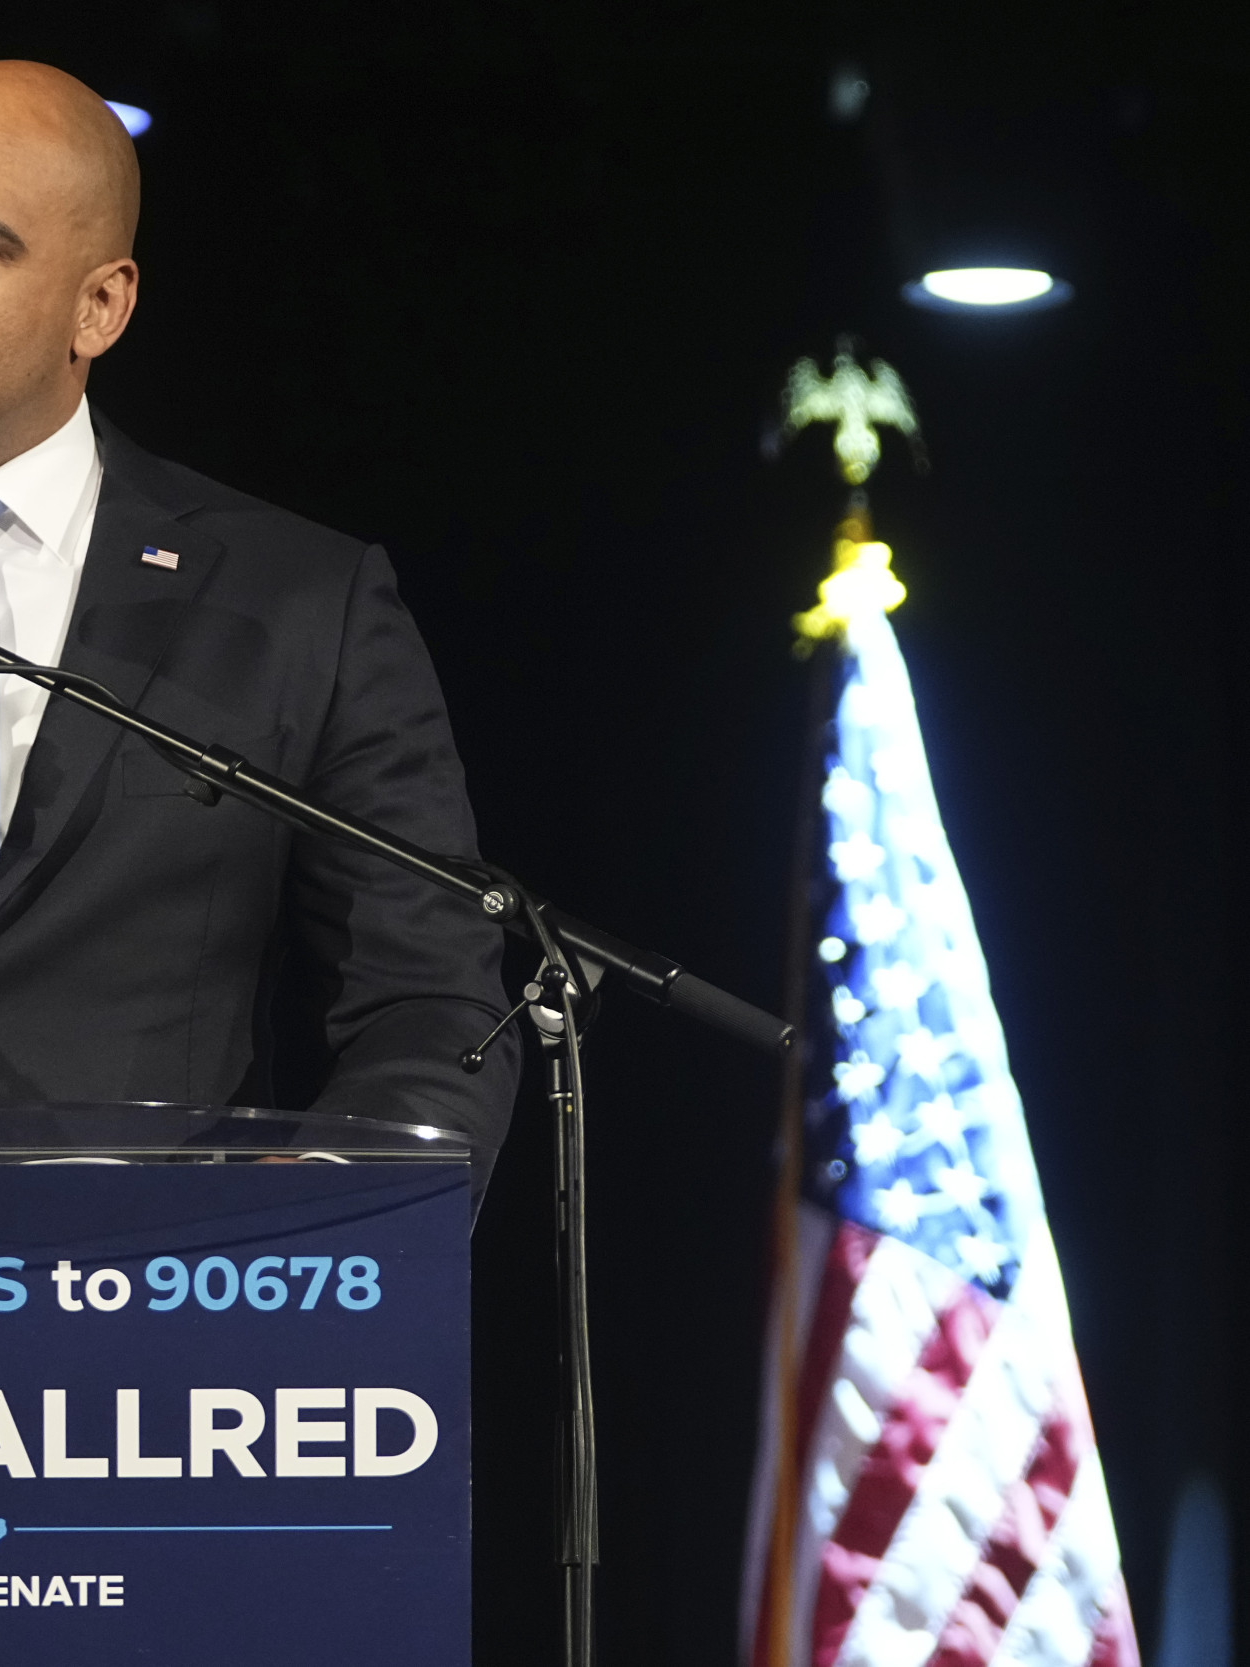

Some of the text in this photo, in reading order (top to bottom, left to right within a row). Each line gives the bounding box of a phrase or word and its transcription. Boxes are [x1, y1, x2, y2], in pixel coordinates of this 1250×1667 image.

[483, 894, 504, 911] K&M
[51, 1260, 132, 1312] to
[144, 1256, 382, 1312] 90678
